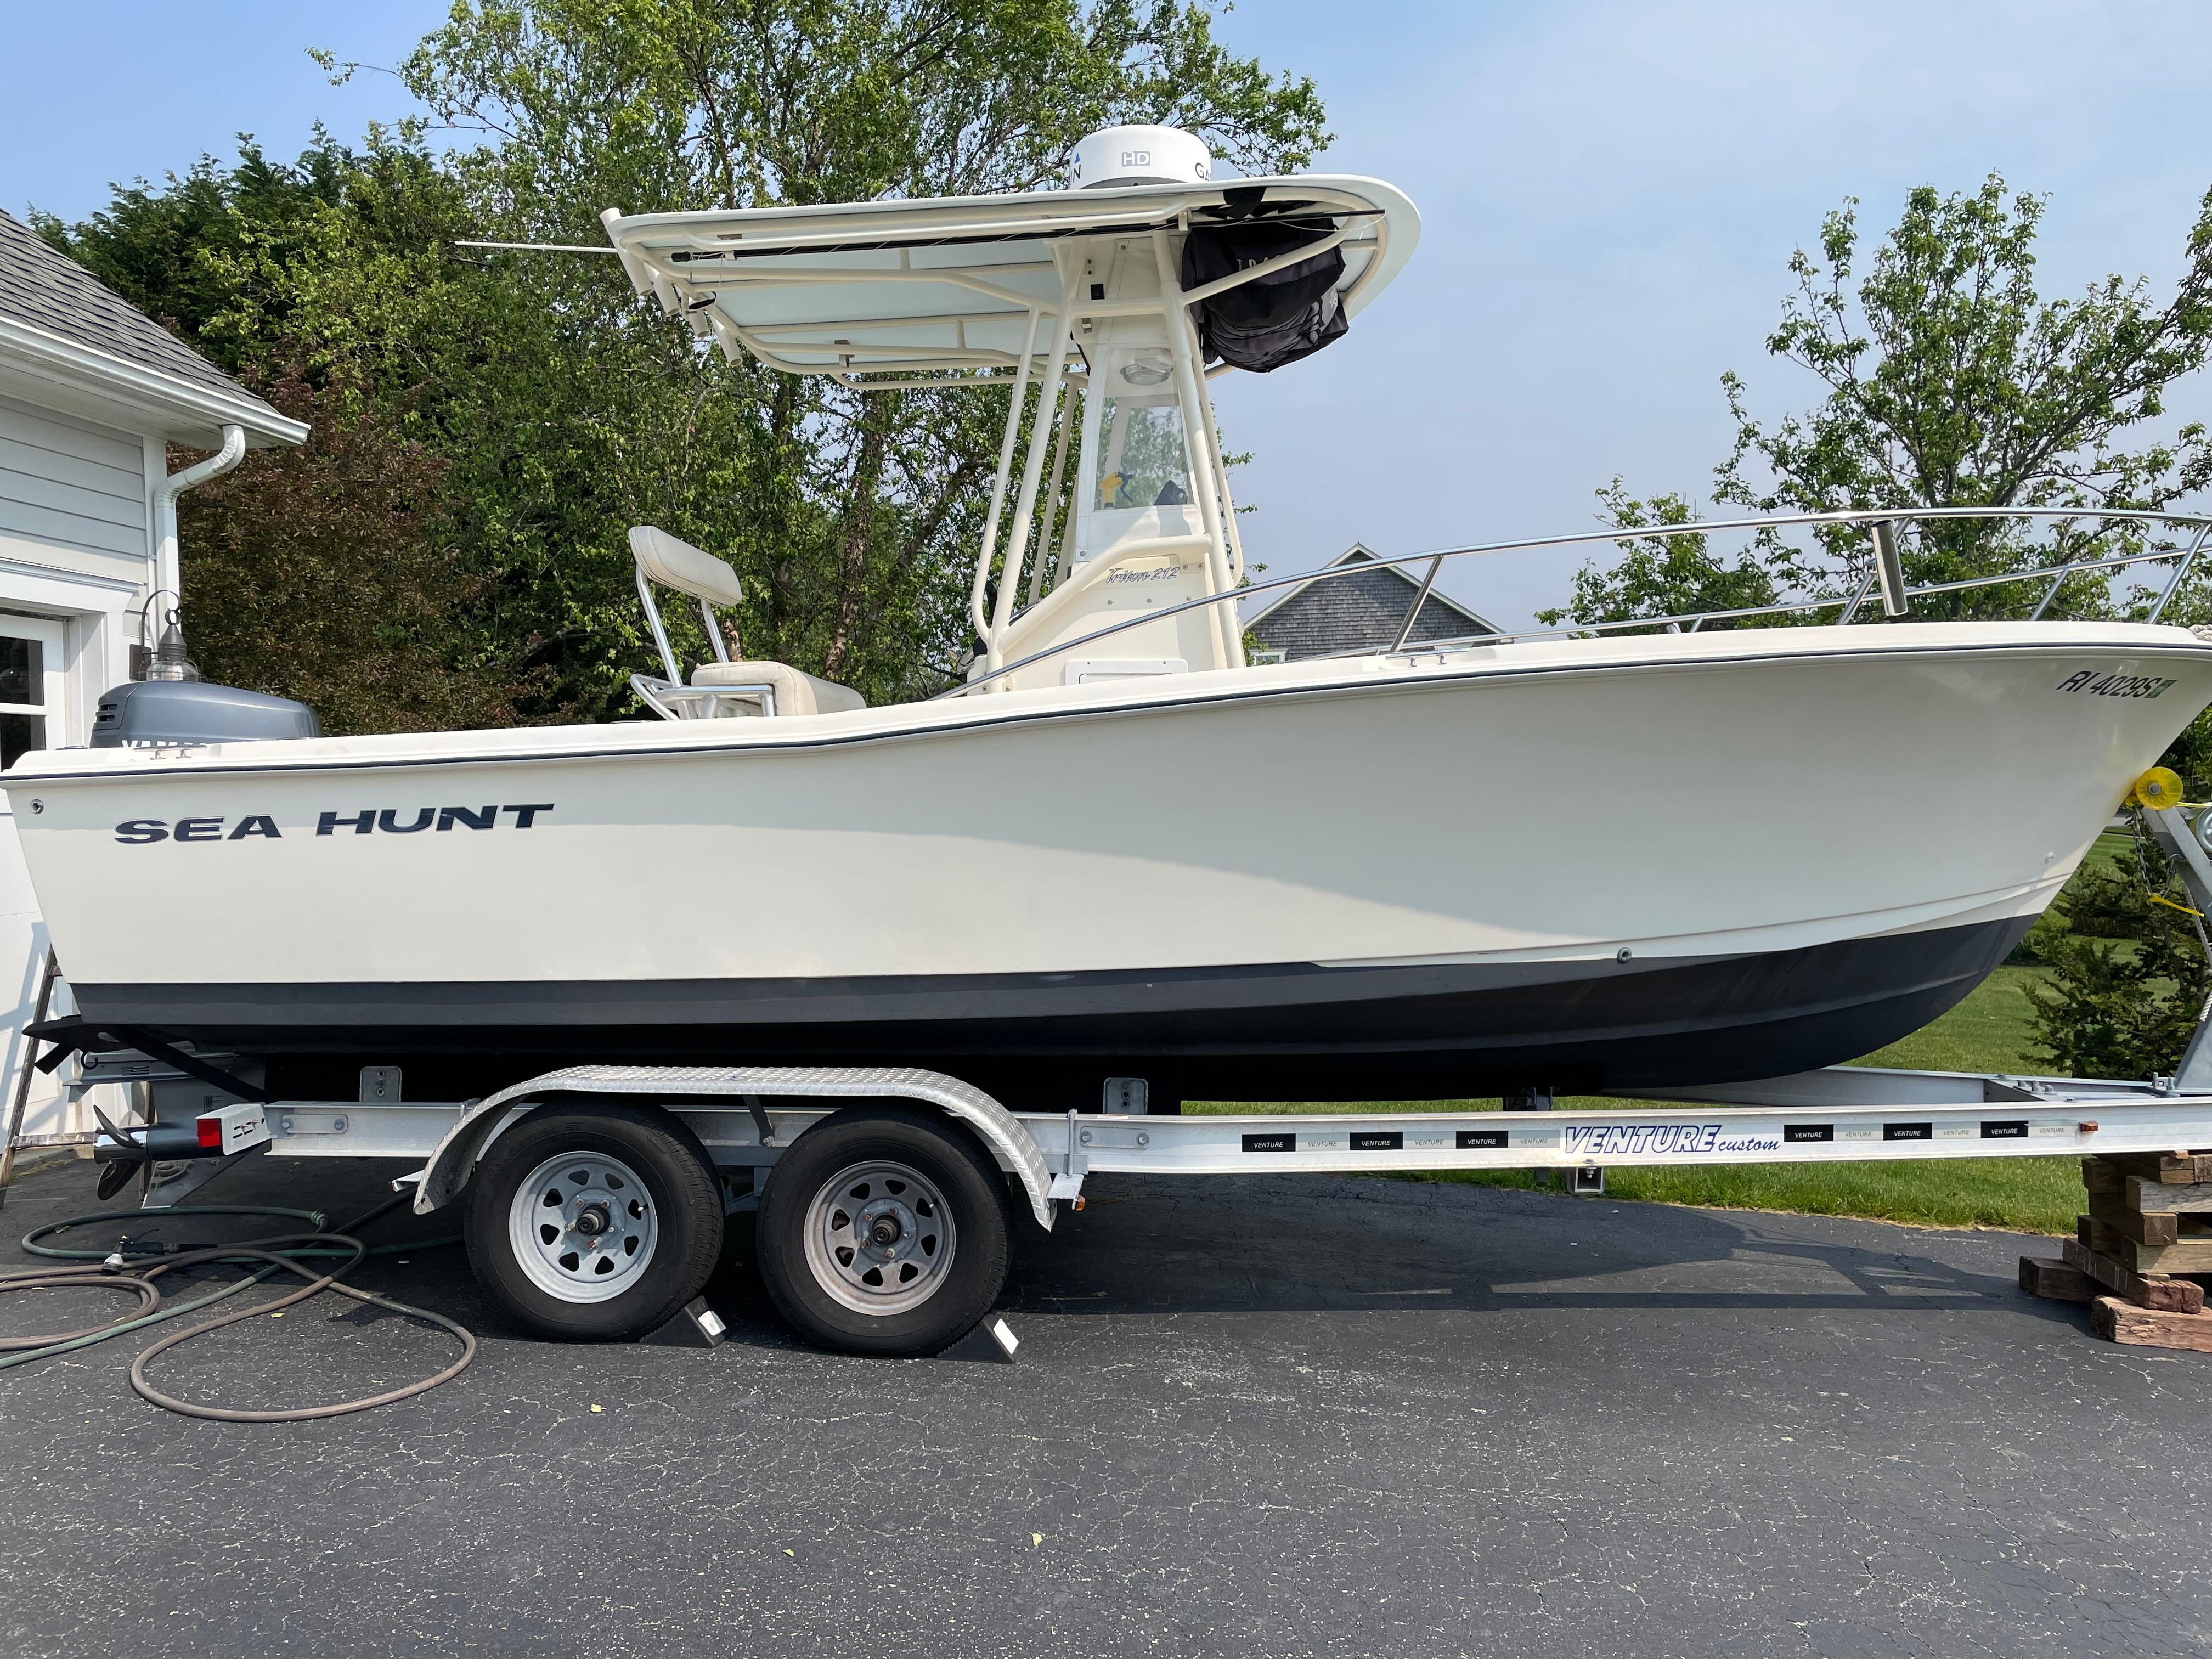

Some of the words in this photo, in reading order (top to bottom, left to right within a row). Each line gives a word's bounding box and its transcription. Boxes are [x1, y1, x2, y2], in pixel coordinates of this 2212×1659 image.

[1122, 151, 1150, 166] HD
[1195, 162, 1210, 182] GA
[1105, 567, 1150, 584] Triton
[1150, 566, 1181, 581] 212
[2055, 670, 2101, 692] RI
[114, 814, 283, 845] SEA
[315, 803, 555, 837] HUNT
[1565, 1124, 1723, 1154] VENTURE
[1718, 1137, 1781, 1152] custom
